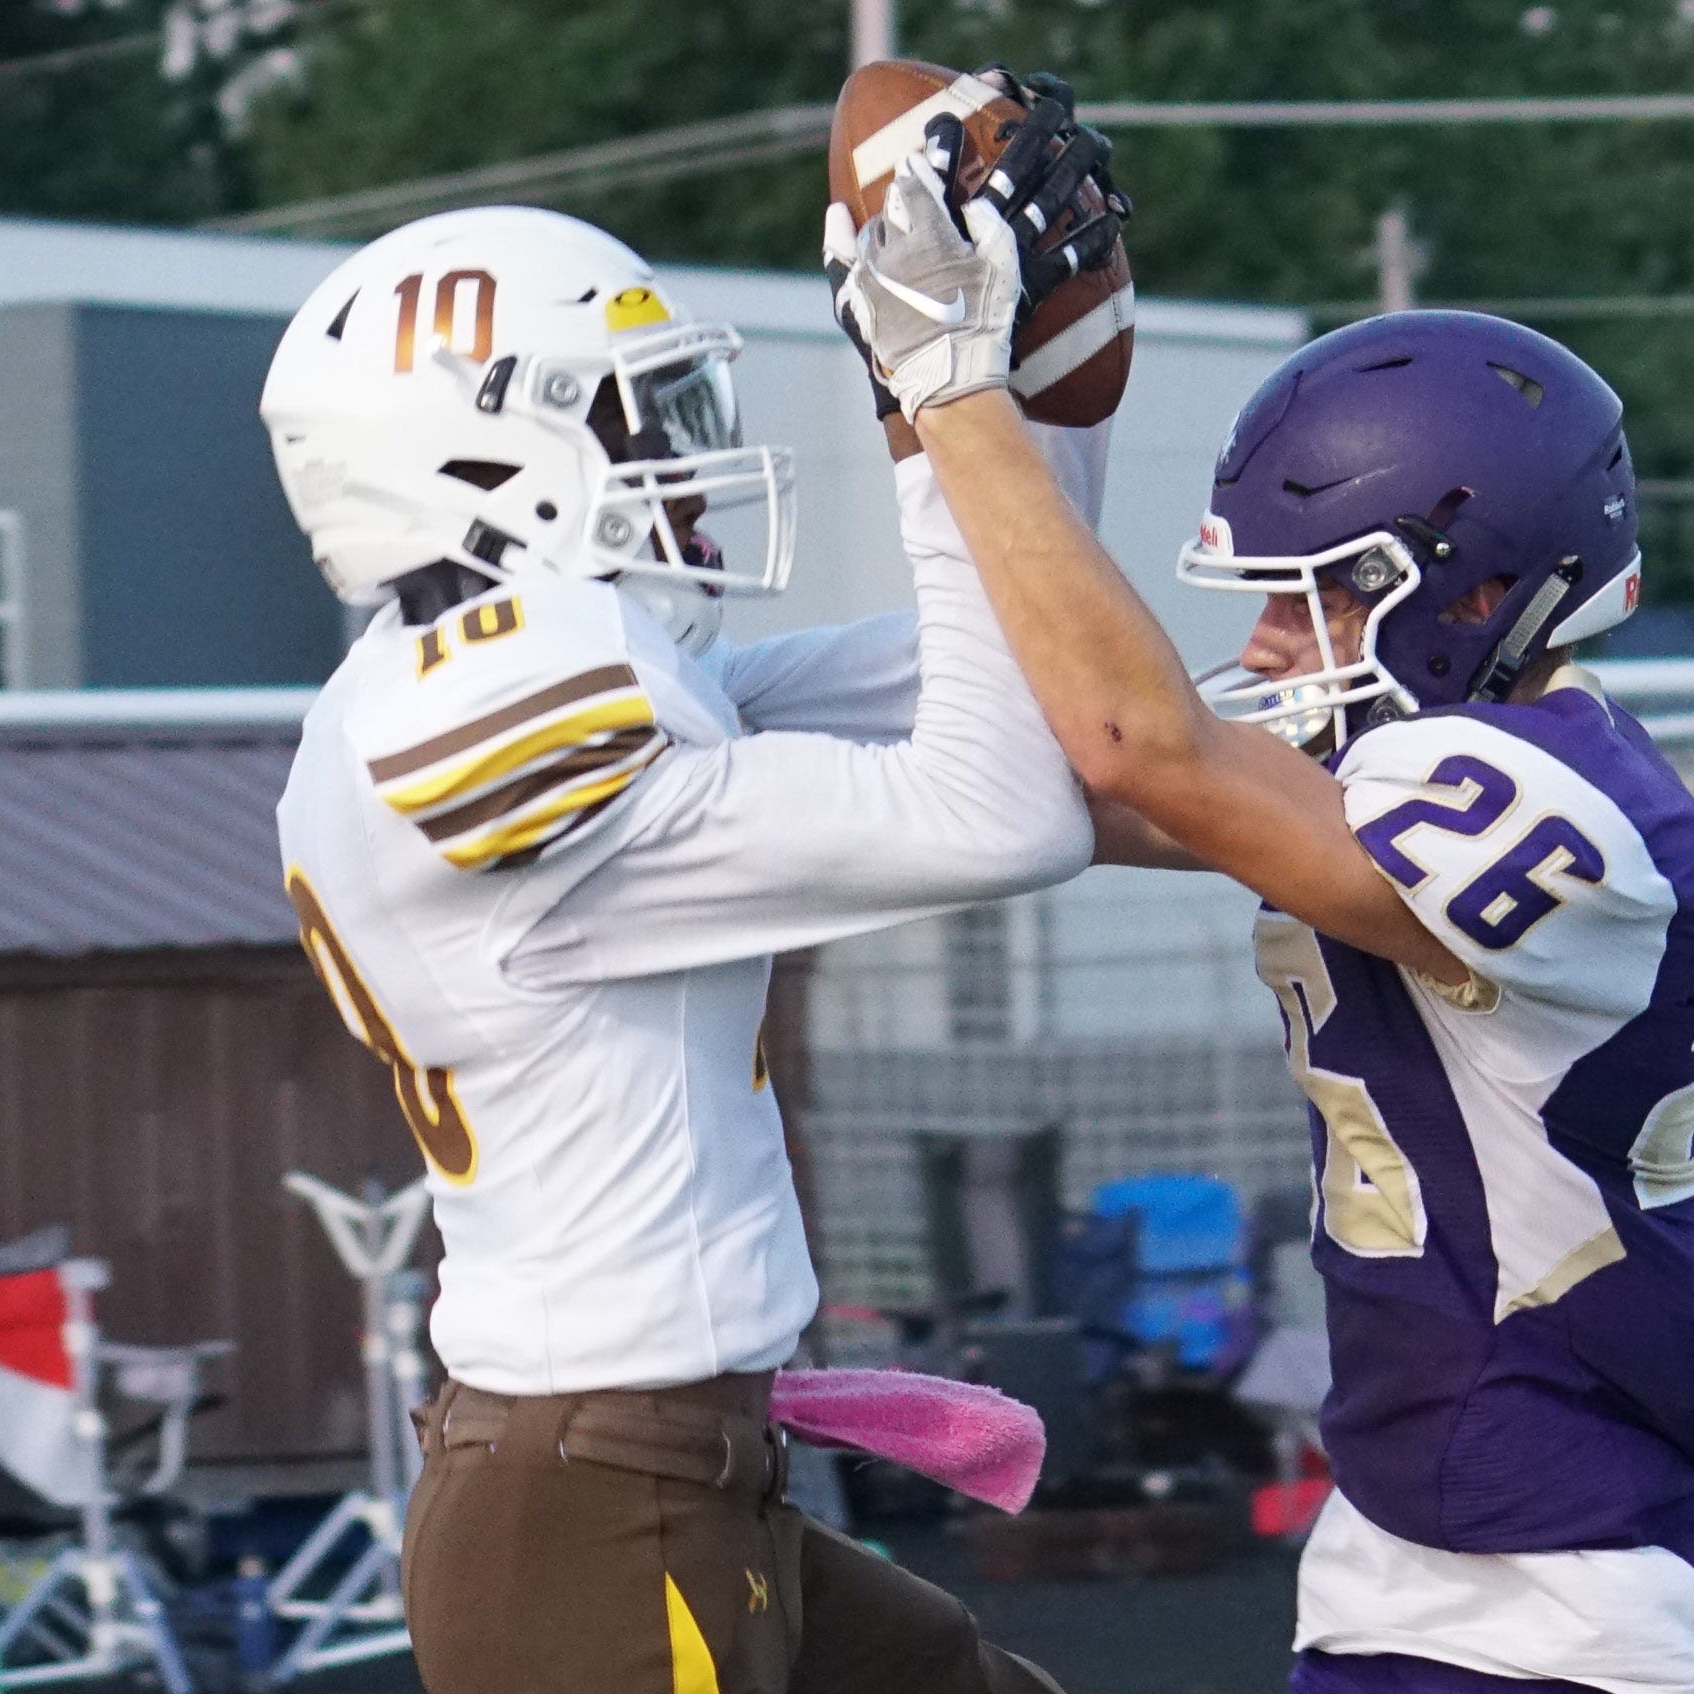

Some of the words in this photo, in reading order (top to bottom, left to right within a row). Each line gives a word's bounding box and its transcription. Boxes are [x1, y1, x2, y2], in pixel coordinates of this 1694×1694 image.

[394, 269, 497, 373] 10
[1351, 752, 1608, 954] 26
[1251, 904, 1429, 1258] 6
